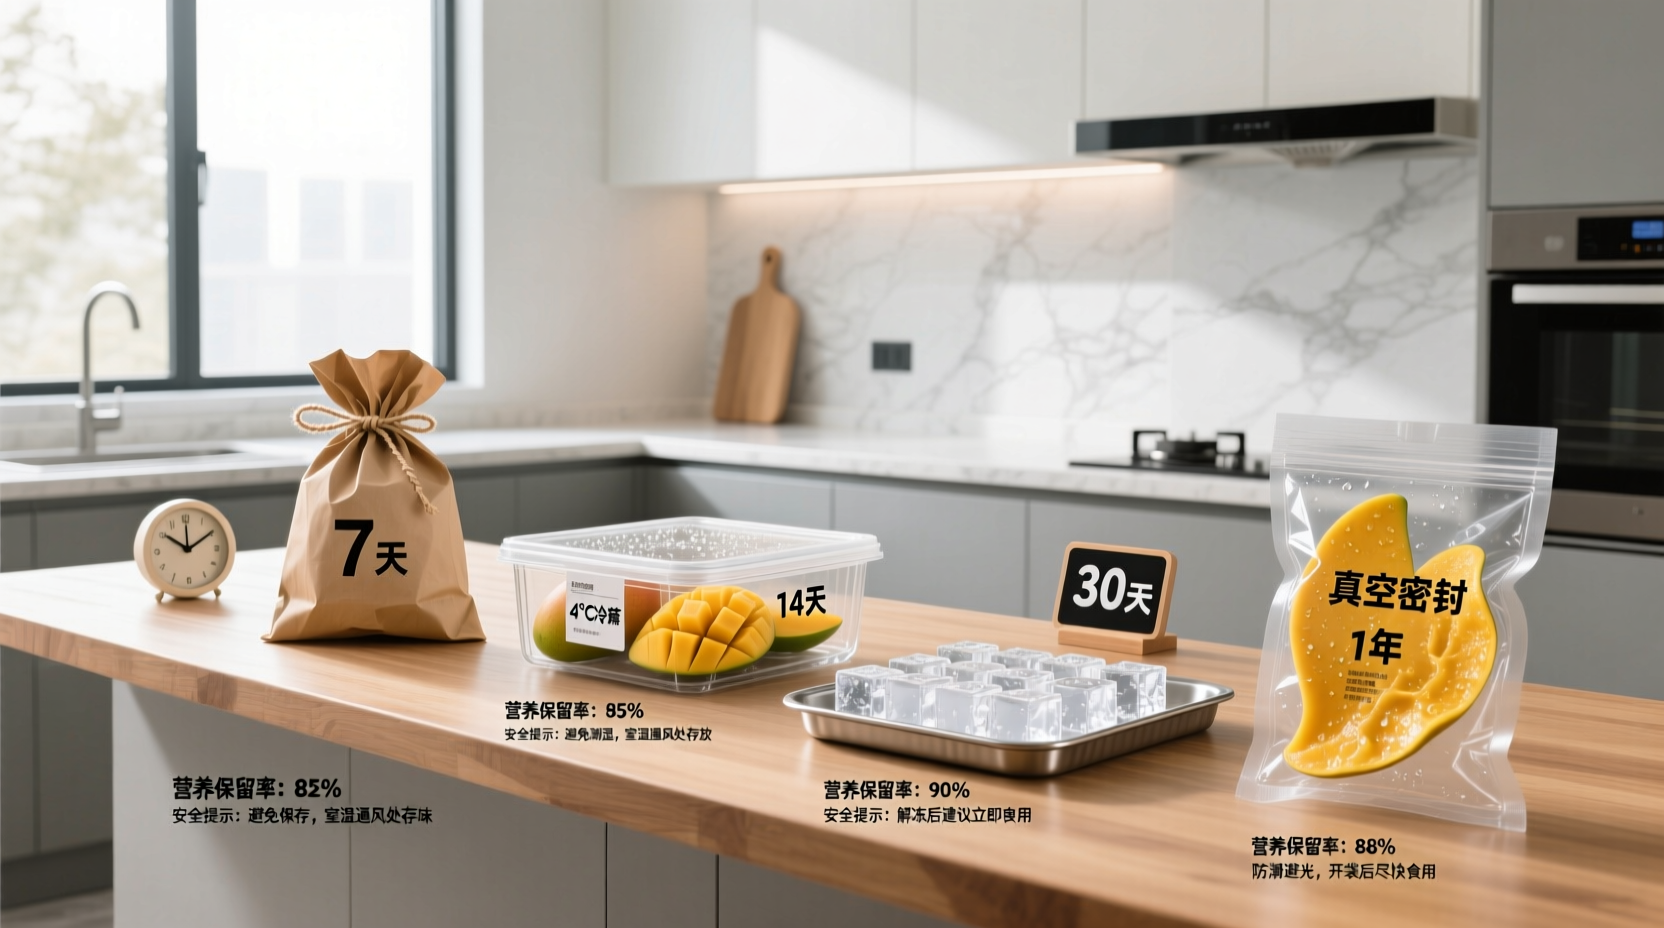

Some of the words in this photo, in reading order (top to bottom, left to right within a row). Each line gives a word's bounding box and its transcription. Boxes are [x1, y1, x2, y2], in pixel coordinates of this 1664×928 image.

[334, 519, 408, 577] 7天
[777, 585, 826, 619] 14天
[1072, 564, 1153, 616] 30天
[1329, 570, 1468, 615] 真空密封
[1351, 628, 1404, 665] 1年
